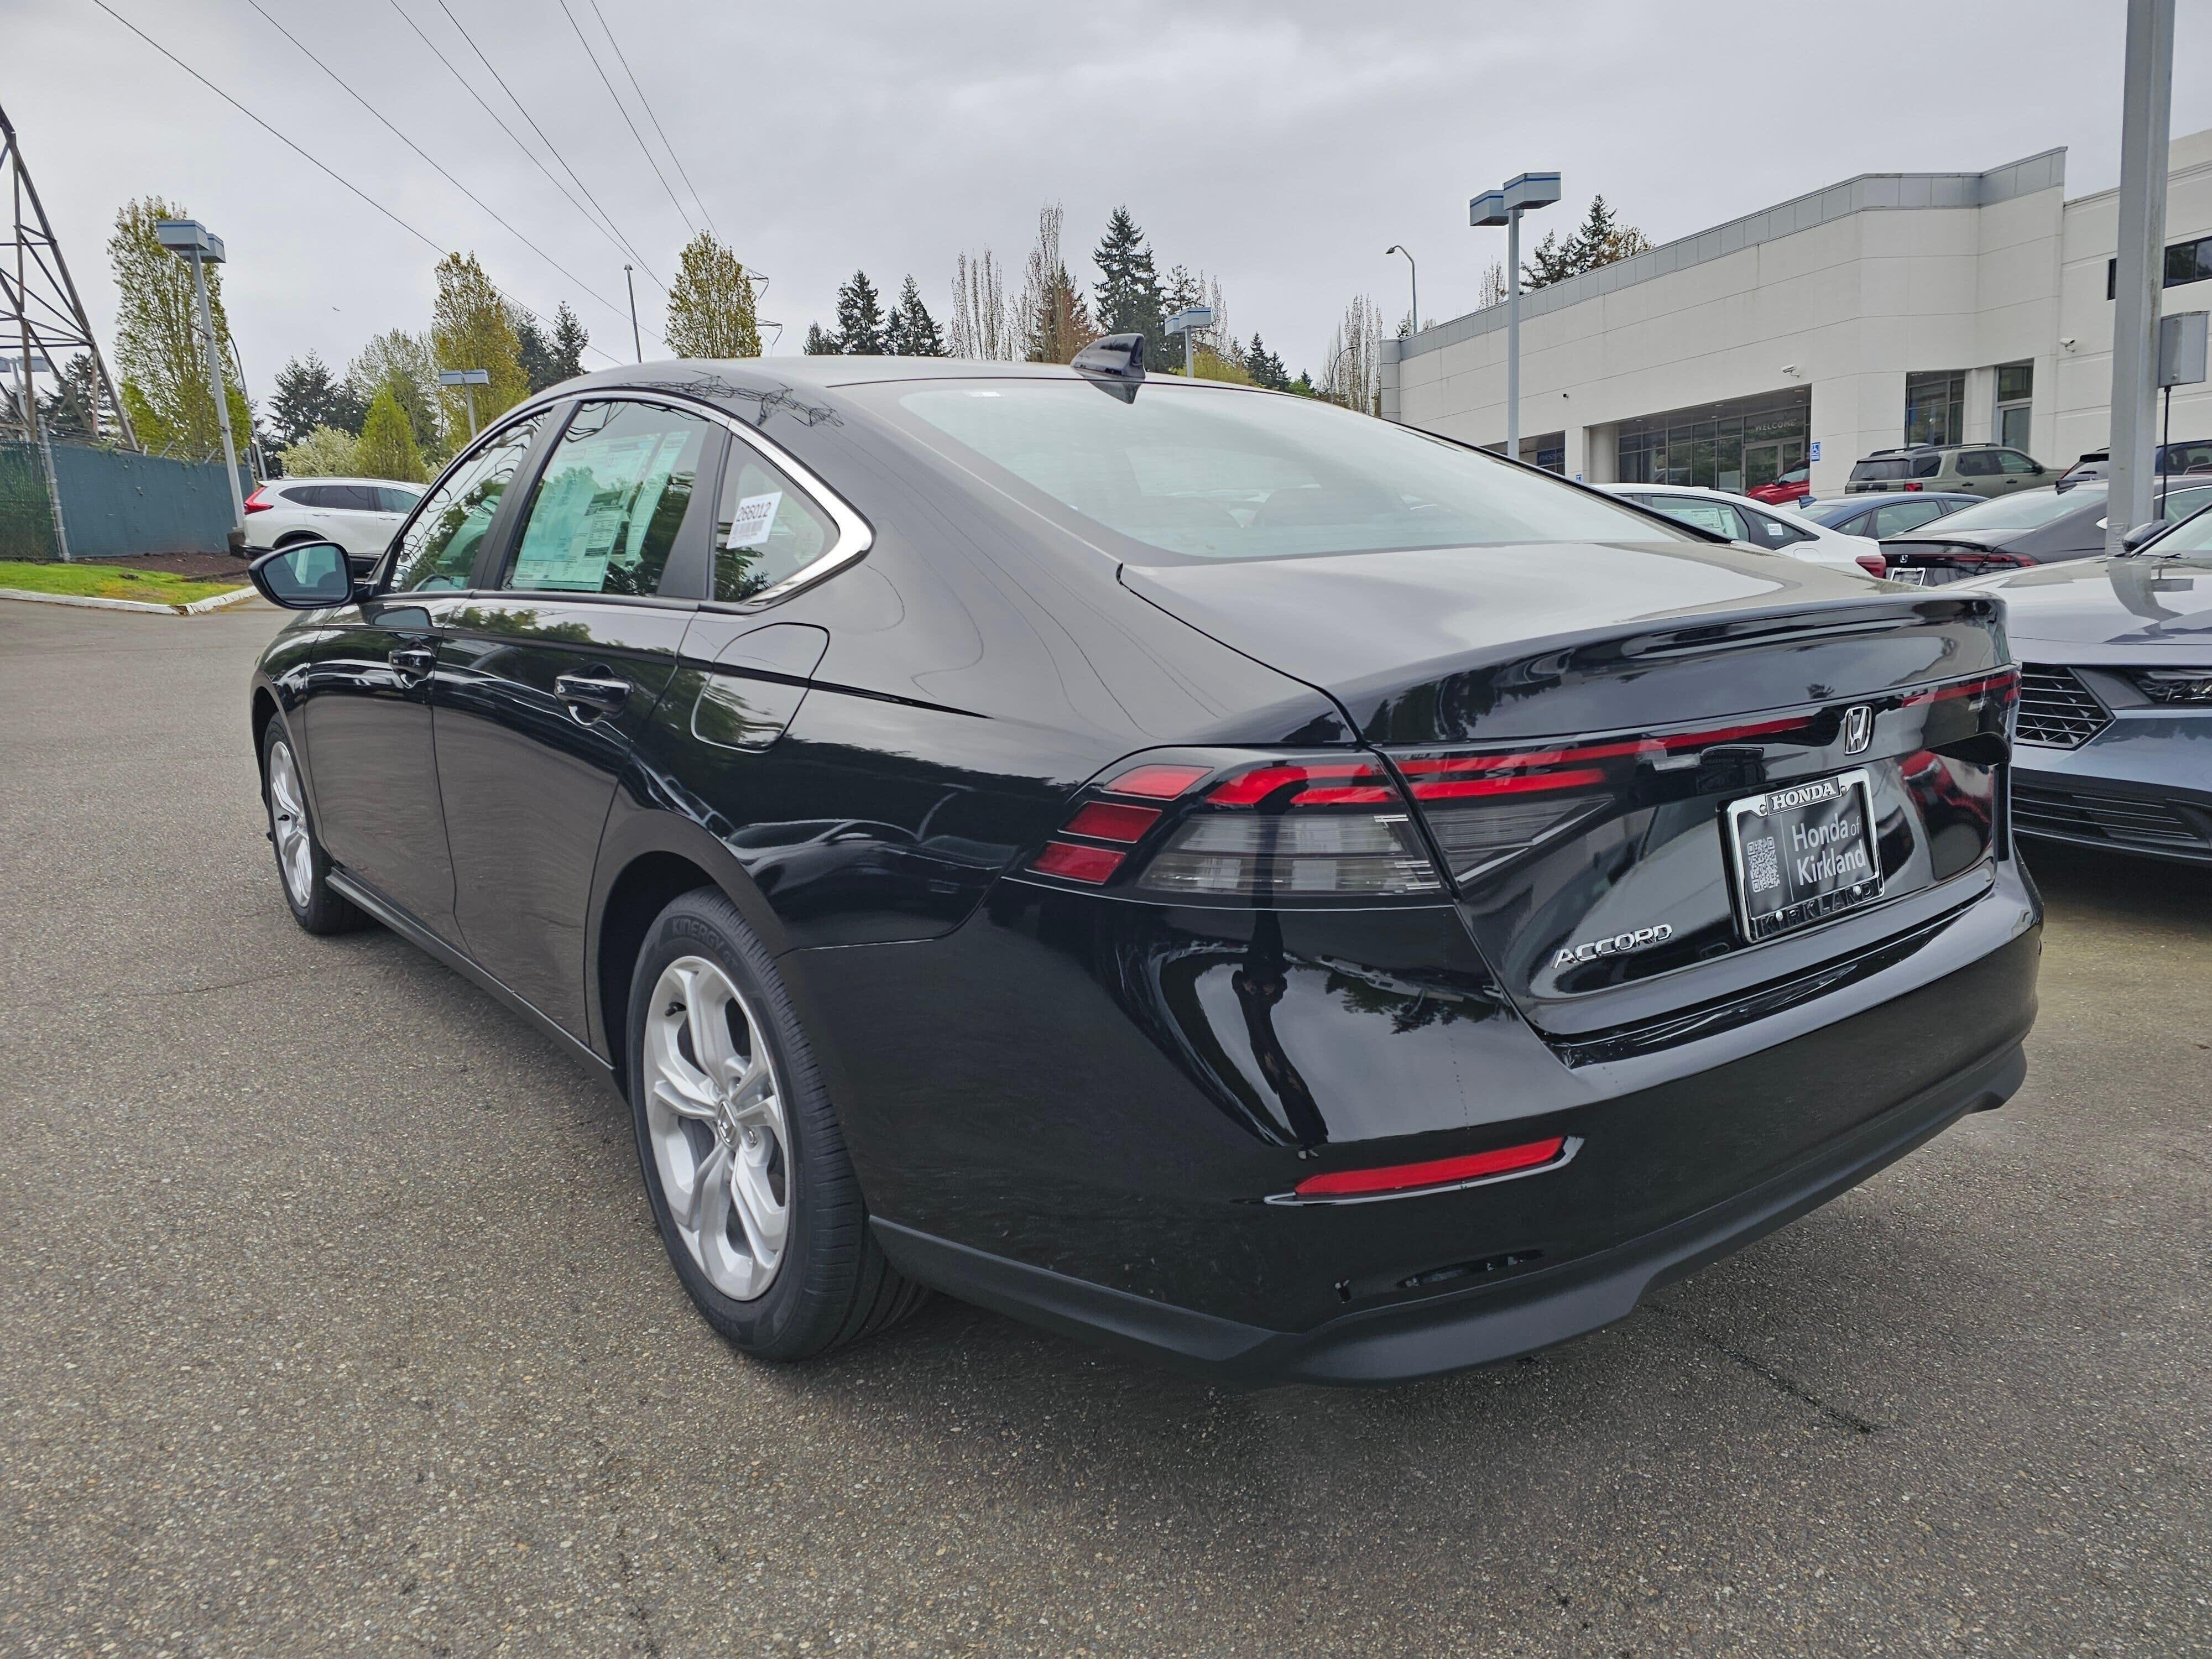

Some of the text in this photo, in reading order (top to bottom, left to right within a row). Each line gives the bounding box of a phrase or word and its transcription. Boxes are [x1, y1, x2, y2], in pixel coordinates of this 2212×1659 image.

[1755, 419, 1797, 431] WELCOME
[1770, 782, 1837, 811] HONDA
[1791, 812, 1860, 852] Honda of
[1797, 839, 1866, 886] Kirkland
[1760, 881, 1875, 933] KIRKLAND
[672, 918, 725, 952] KINERGY
[1551, 924, 1672, 968] ACCORD
